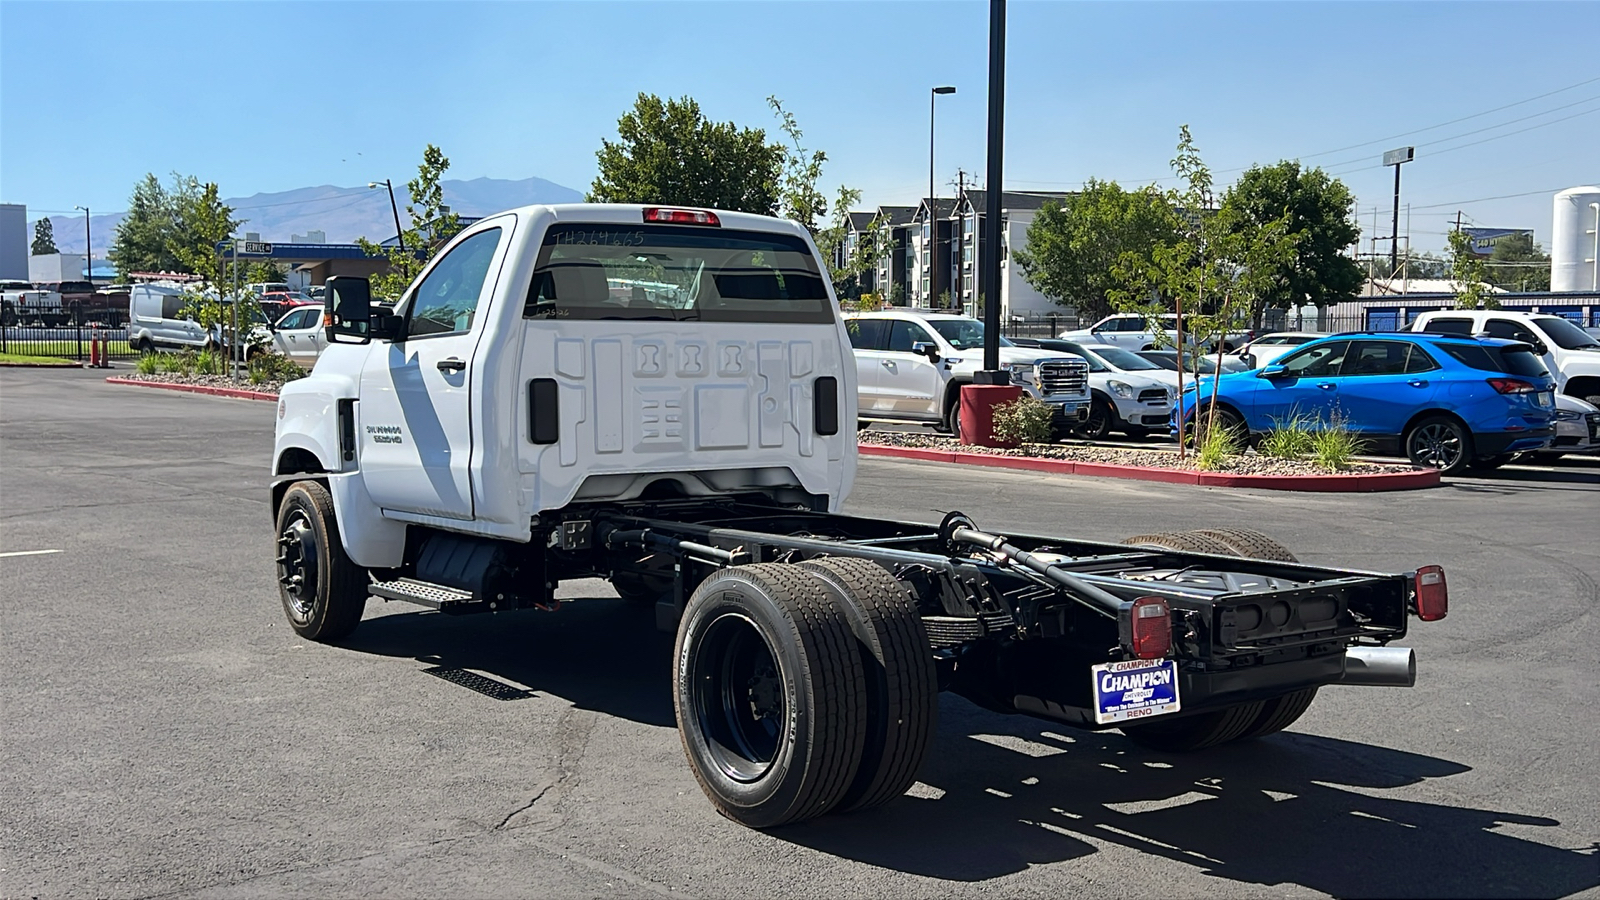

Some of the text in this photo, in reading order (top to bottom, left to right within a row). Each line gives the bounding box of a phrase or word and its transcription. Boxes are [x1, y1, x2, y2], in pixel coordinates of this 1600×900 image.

[553, 230, 645, 247] TH264665
[246, 243, 265, 252] SERVICE
[1116, 659, 1155, 671] CHAMPION
[1101, 669, 1171, 693] CHAMPION
[1126, 708, 1153, 718] RENO
